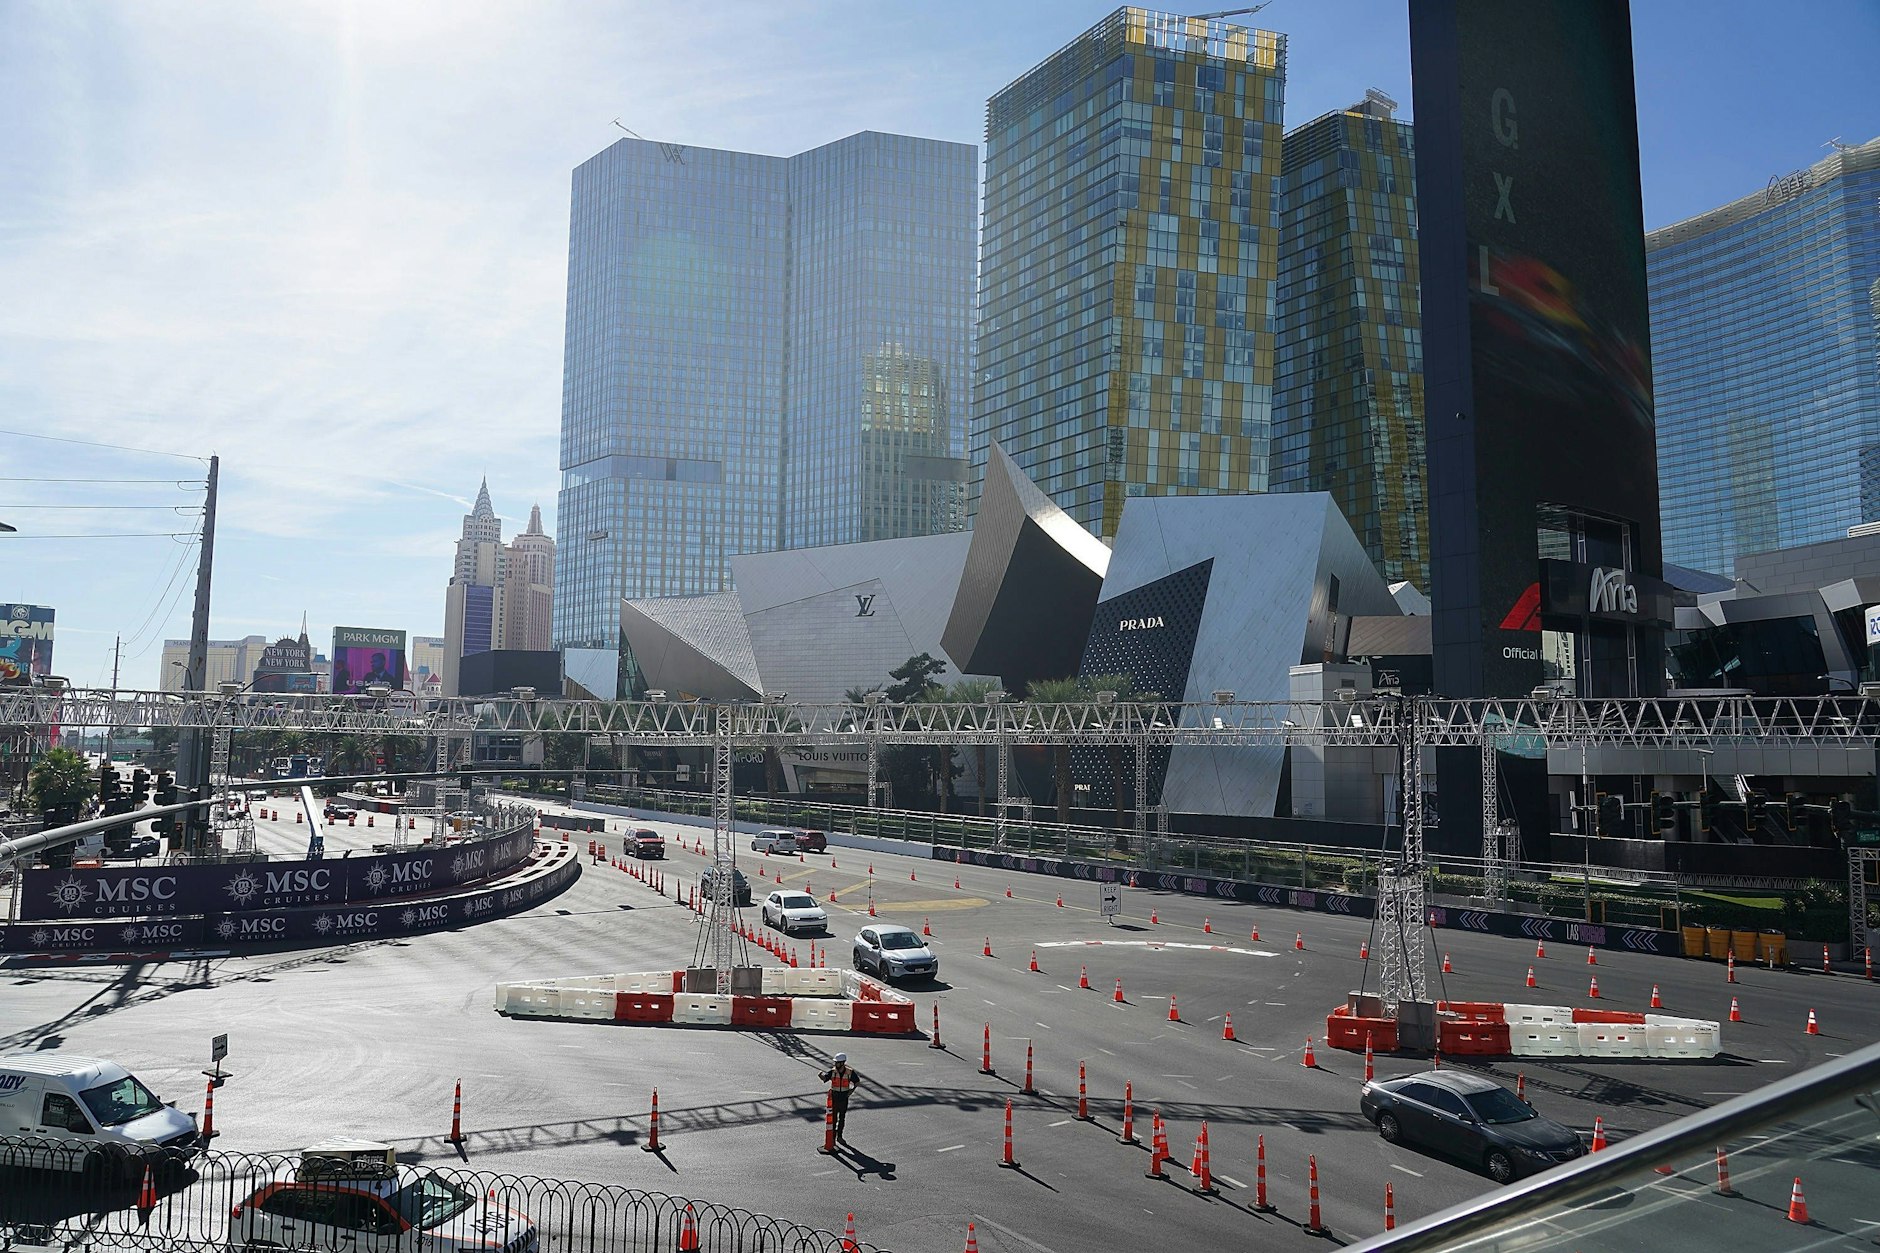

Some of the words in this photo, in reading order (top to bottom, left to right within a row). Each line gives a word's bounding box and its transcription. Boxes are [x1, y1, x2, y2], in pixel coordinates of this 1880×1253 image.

[1590, 567, 1638, 614] Aria
[1119, 616, 1165, 631] PRADA
[343, 632, 370, 643] PARK
[372, 634, 399, 644] MGM
[265, 648, 283, 657] NEW
[285, 648, 306, 658] YORK
[1503, 646, 1538, 660] Official
[265, 657, 283, 667] NEW
[284, 658, 305, 668] YORK
[1378, 672, 1400, 686] Aria
[799, 752, 829, 761] LOUIS
[832, 752, 869, 762] VUITTO
[465, 849, 485, 871] MSC
[390, 858, 433, 883] MSC
[264, 868, 331, 894] MSC
[390, 882, 432, 894] CRUISES
[95, 876, 177, 902] MSC
[1104, 886, 1117, 894] KEEP
[264, 893, 330, 905] CRUISES
[474, 896, 494, 912] MSC
[95, 903, 176, 914] CRUISES
[418, 904, 448, 921] MSC
[1103, 904, 1118, 912] RIGHT
[240, 917, 286, 933] MSC
[336, 912, 378, 928] MSC
[52, 927, 95, 942] MSC
[141, 924, 183, 939] MSC
[1566, 923, 1579, 941] LAS
